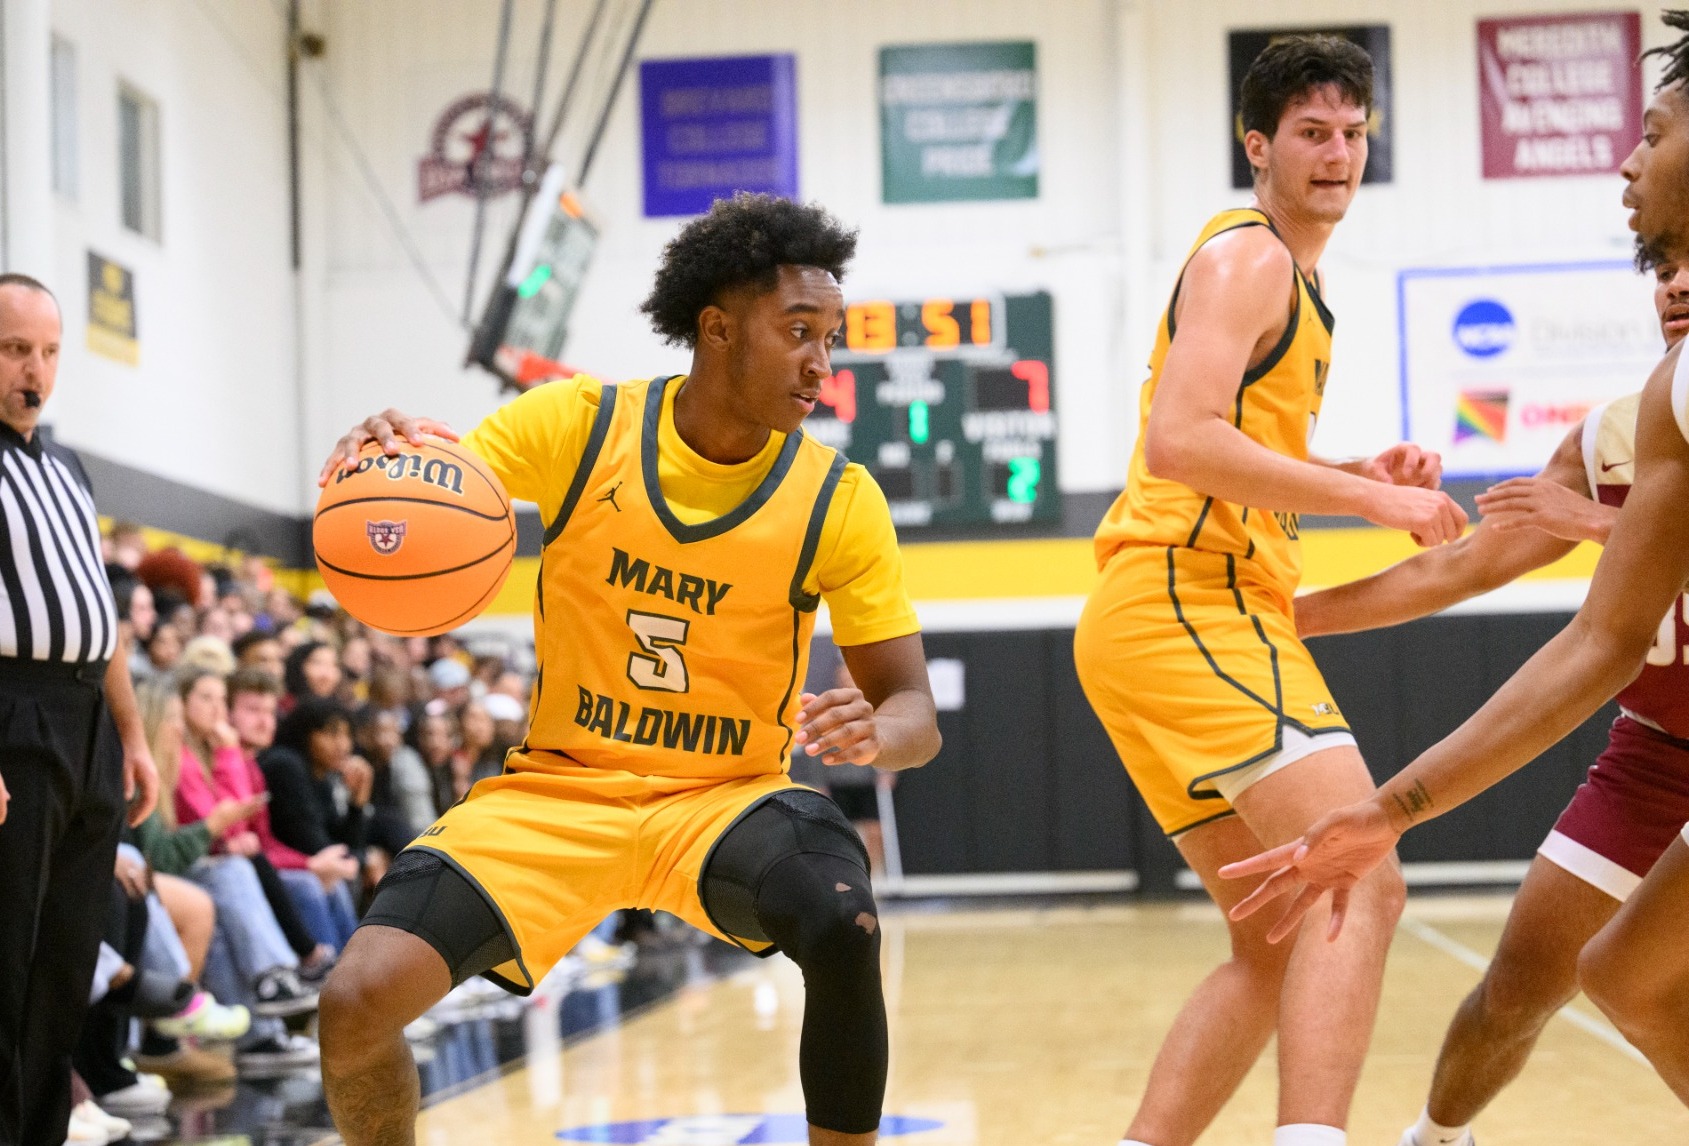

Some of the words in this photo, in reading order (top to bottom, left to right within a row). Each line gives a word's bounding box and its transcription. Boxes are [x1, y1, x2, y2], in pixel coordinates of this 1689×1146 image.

[1513, 134, 1615, 169] ANGELS
[1011, 360, 1049, 415] 7
[908, 400, 929, 444] 1
[1007, 457, 1040, 503] 2
[605, 547, 733, 616] MARY
[626, 609, 690, 693] 5
[574, 684, 751, 756] BALDWIN
